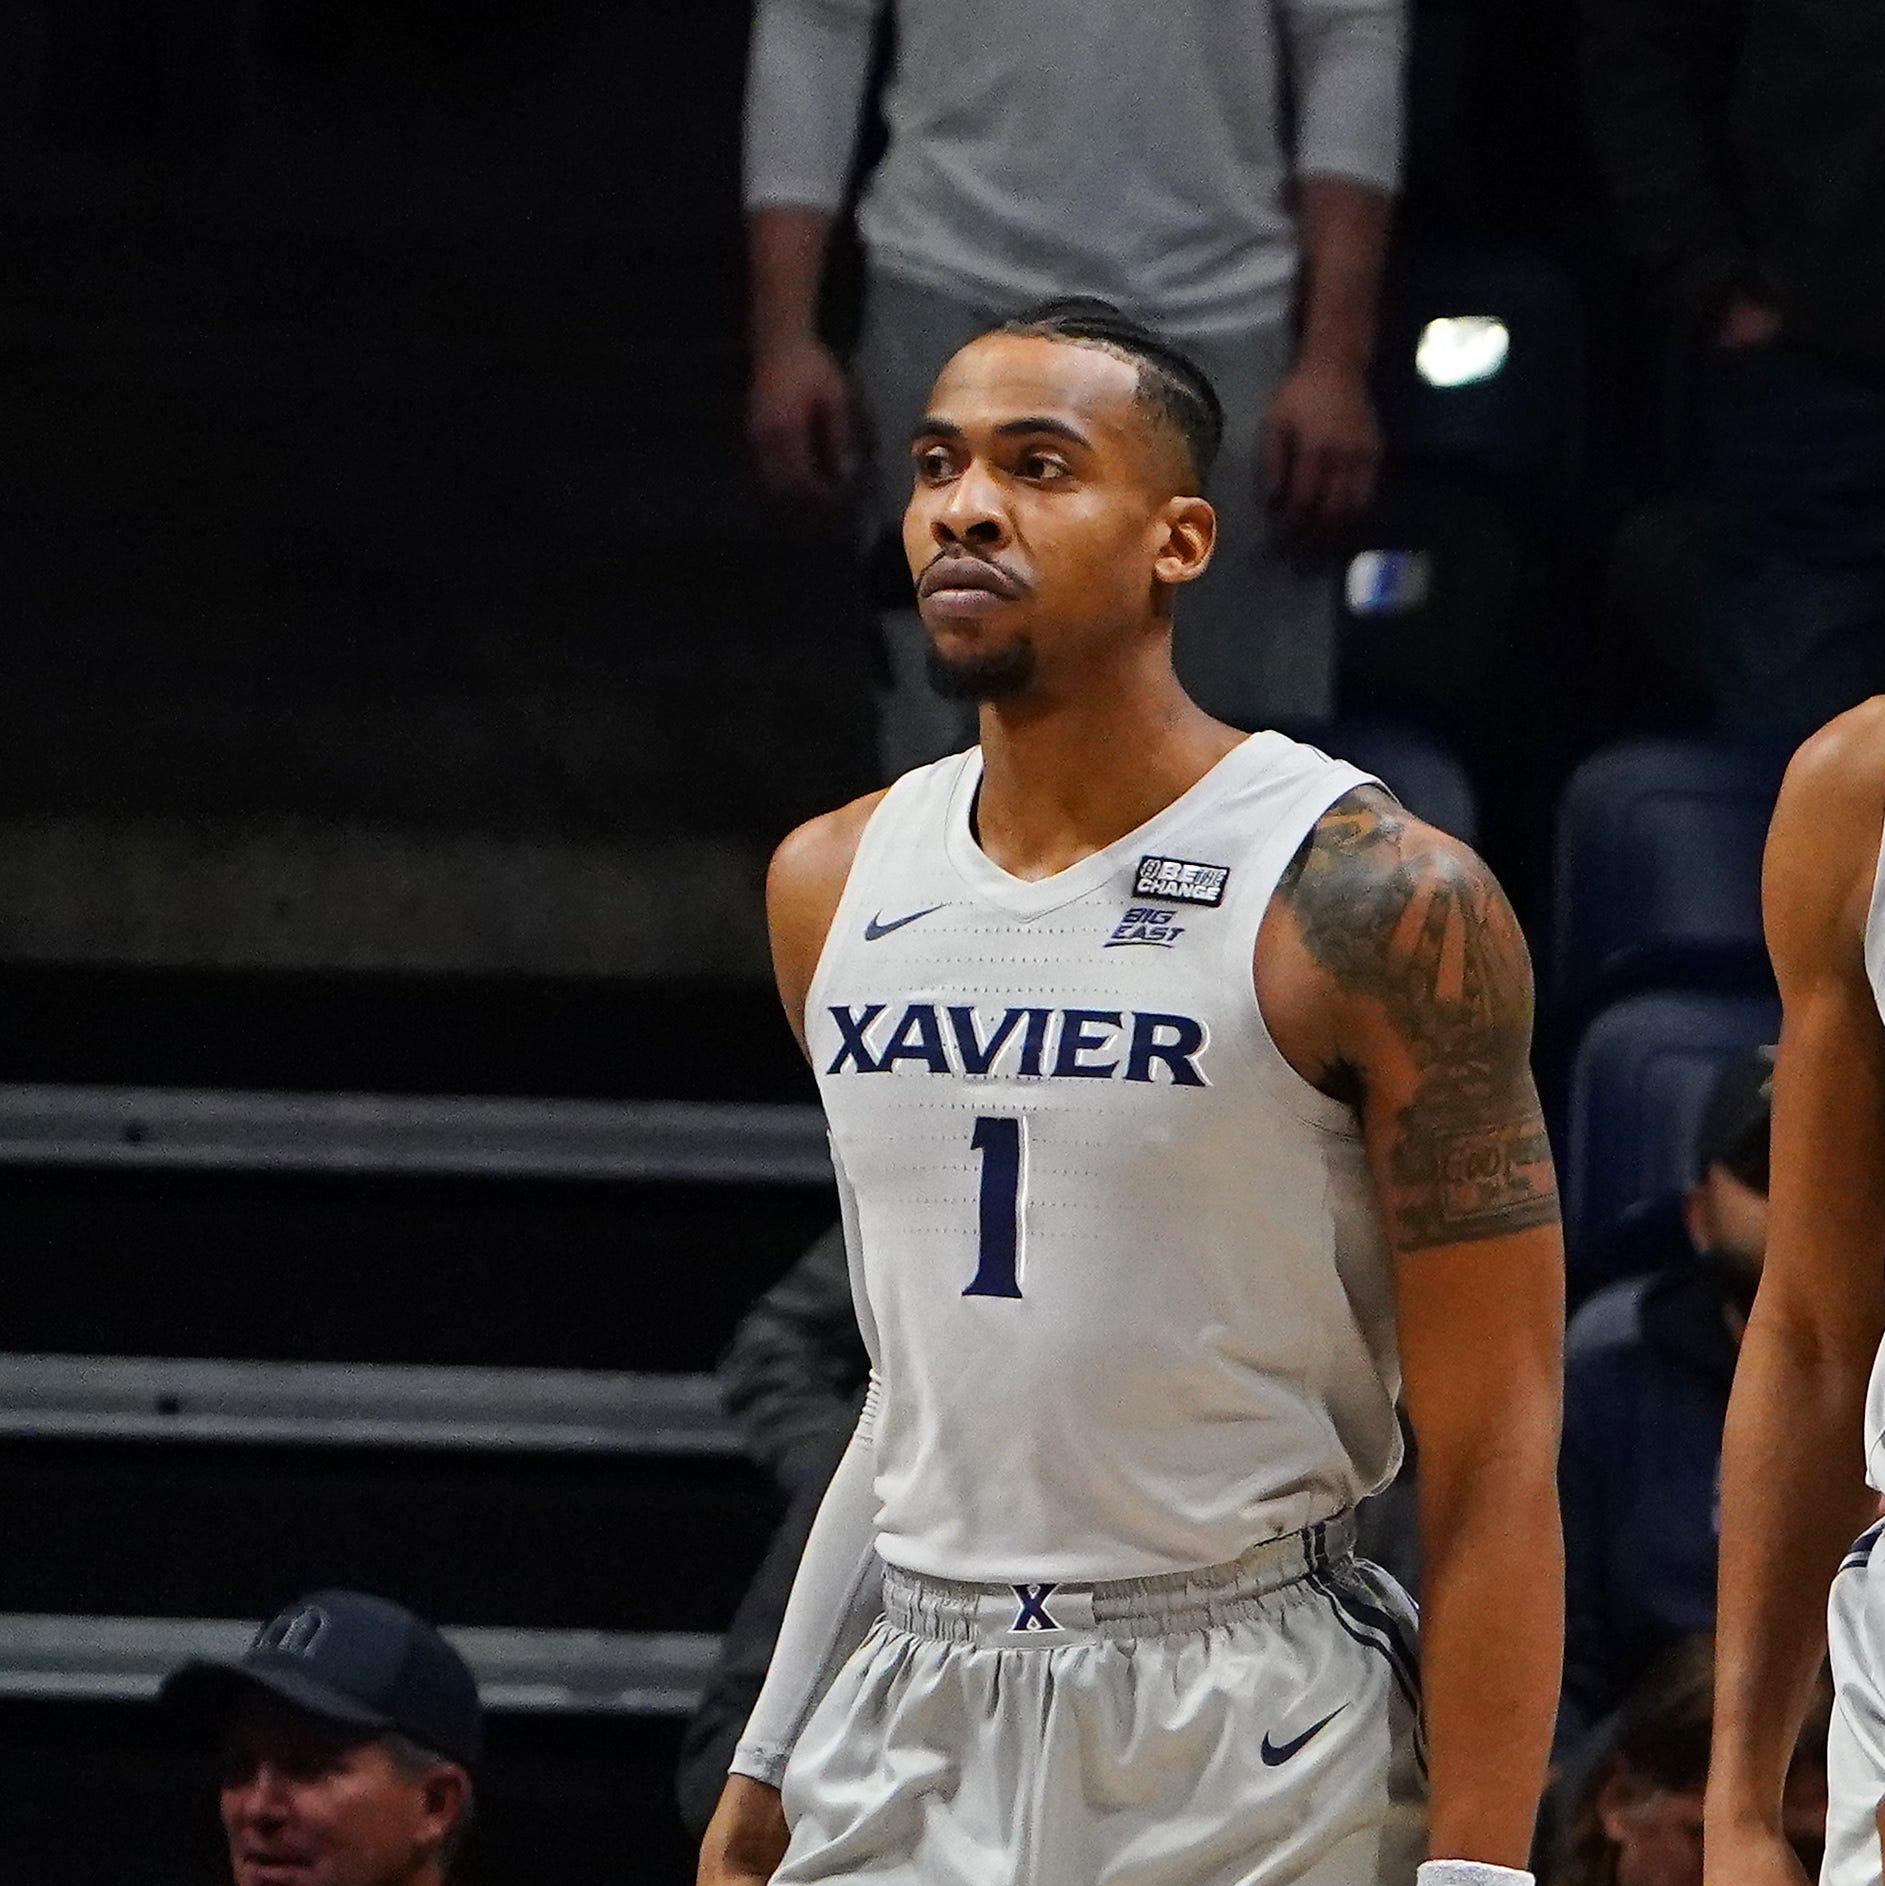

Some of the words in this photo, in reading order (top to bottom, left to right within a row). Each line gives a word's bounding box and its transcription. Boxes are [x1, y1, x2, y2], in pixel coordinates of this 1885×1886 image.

[1136, 878, 1222, 902] CHANGE
[1110, 924, 1186, 942] EAST
[1121, 906, 1178, 926] BIG
[825, 1002, 1214, 1088] XAVIER
[961, 1115, 1028, 1300] 1
[1007, 1582, 1065, 1633] X
